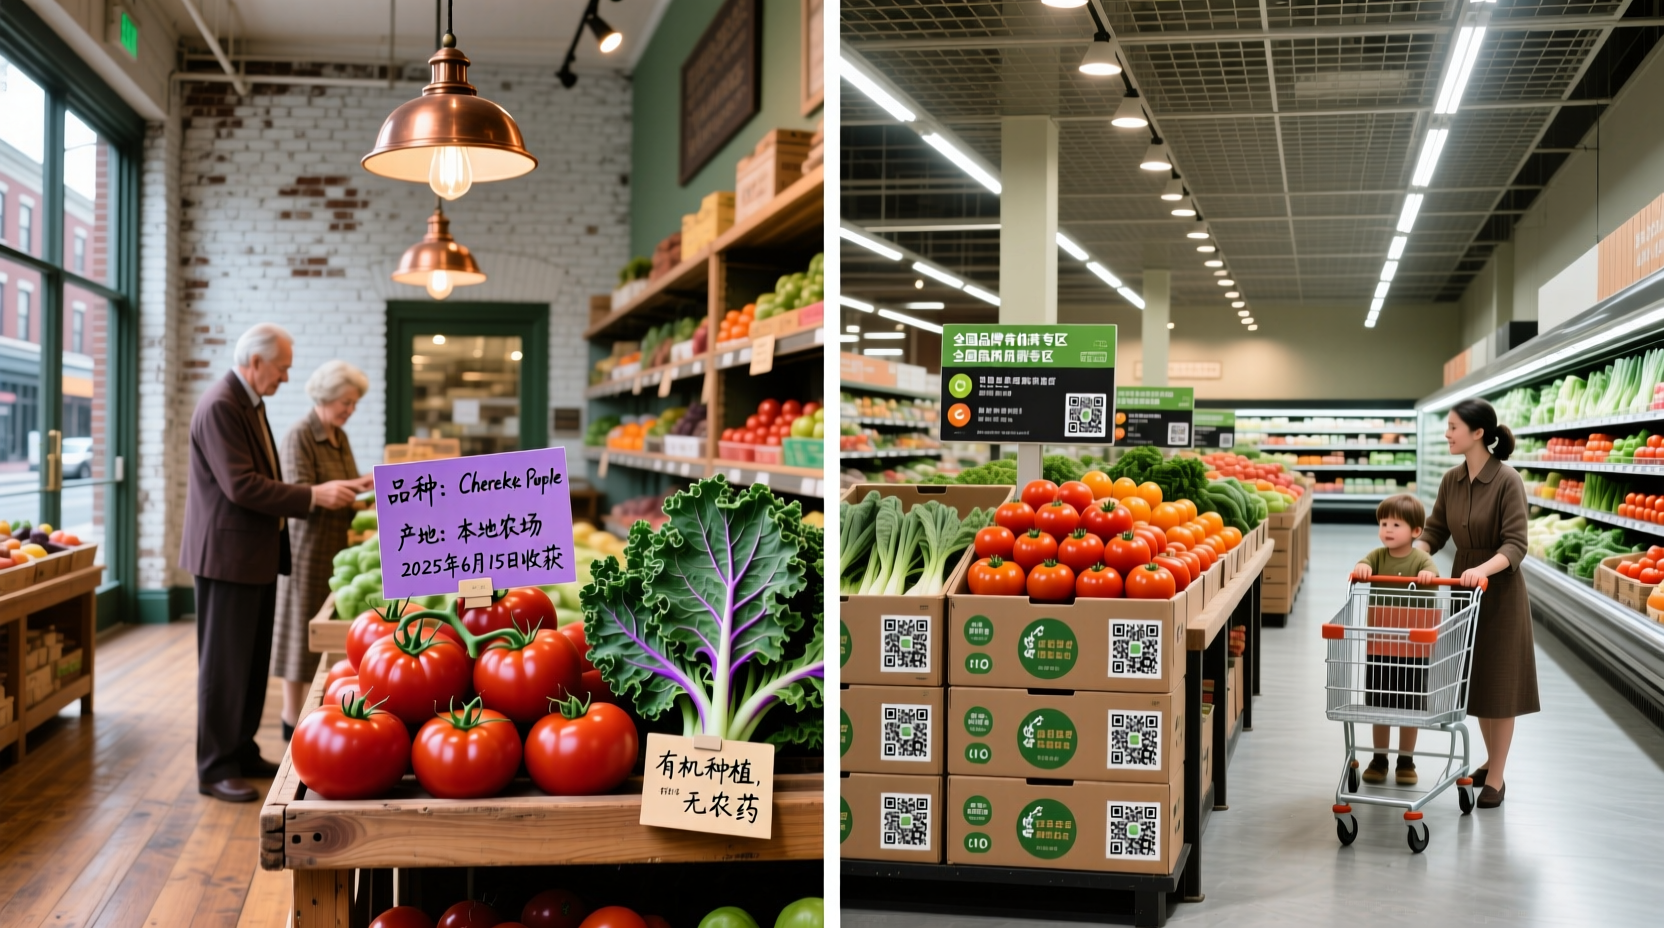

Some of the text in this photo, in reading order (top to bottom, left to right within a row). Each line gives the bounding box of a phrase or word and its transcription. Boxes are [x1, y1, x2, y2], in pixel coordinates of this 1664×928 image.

[526, 467, 563, 495] Puple
[401, 543, 565, 579] 2025年6月15日收获
[683, 791, 760, 824] 无农药
